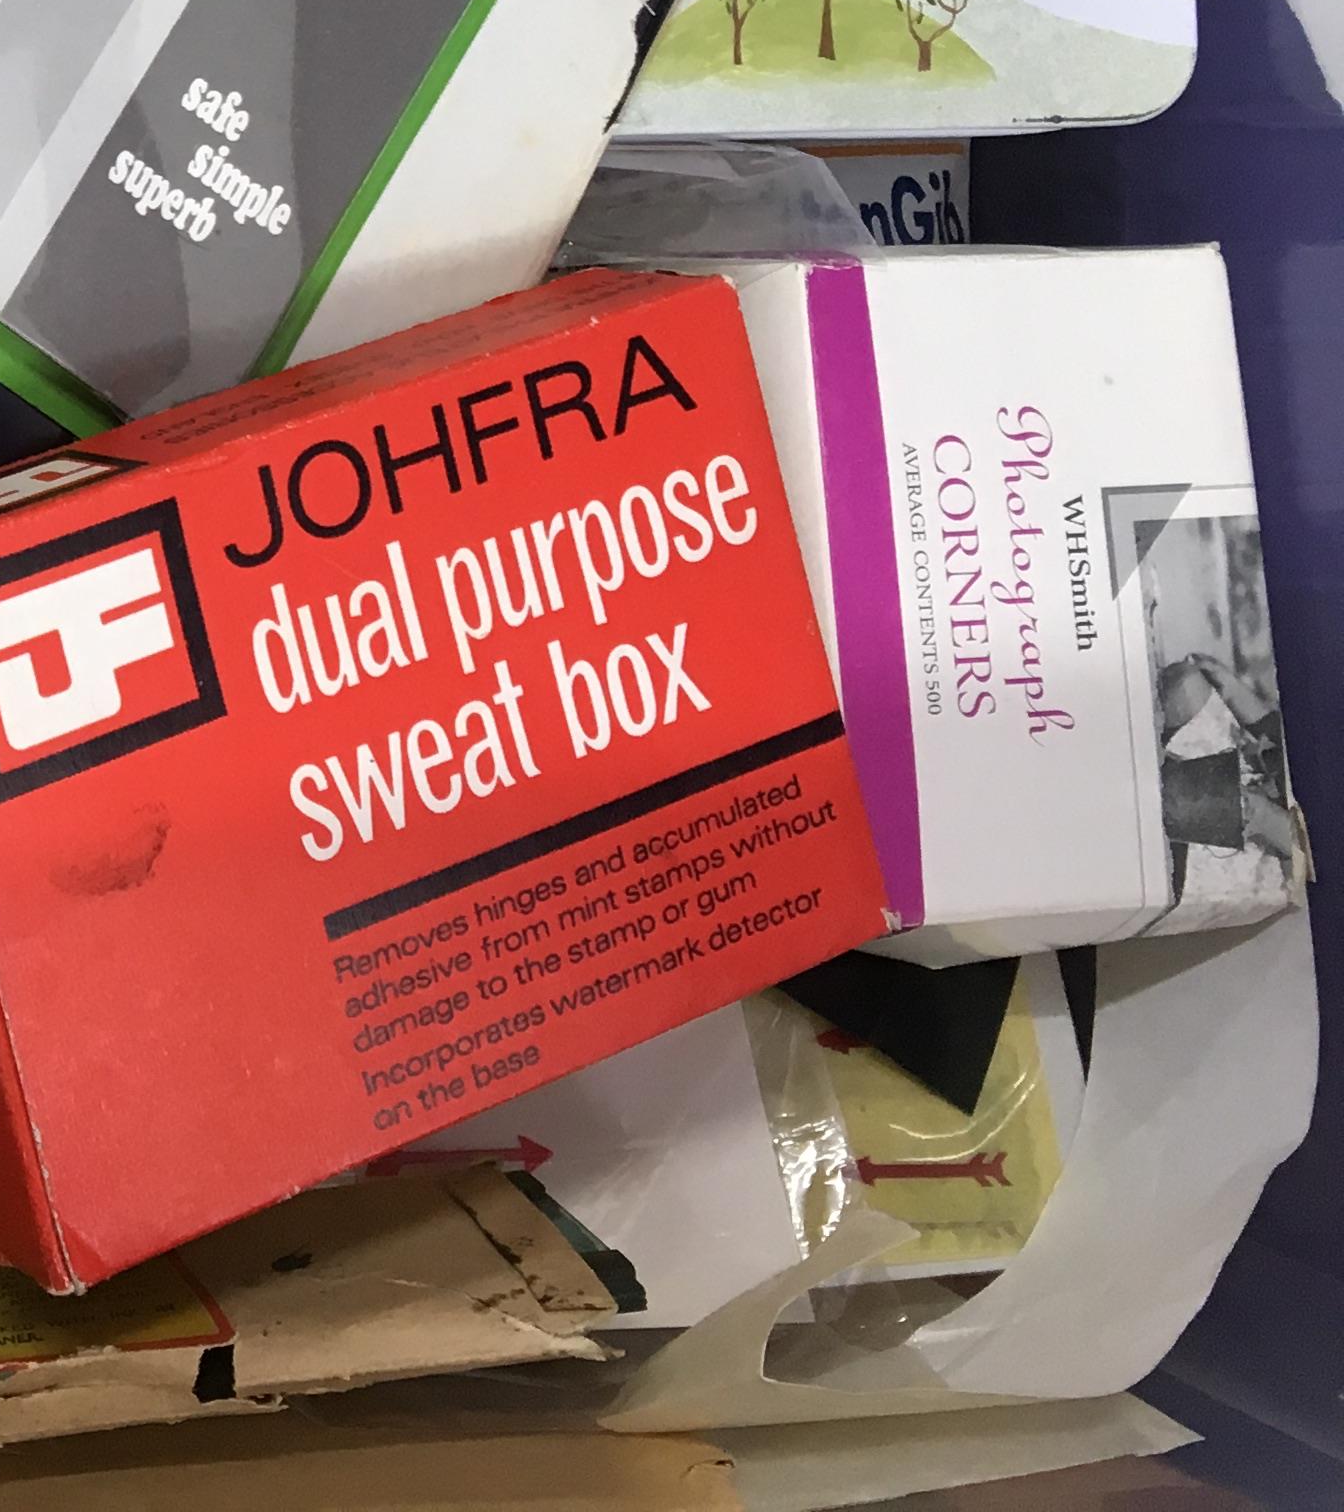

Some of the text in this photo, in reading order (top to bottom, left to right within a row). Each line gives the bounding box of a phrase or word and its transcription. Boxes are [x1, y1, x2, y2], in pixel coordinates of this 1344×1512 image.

[108, 150, 217, 242] superb
[182, 78, 249, 141] safe
[187, 145, 292, 235] simple
[224, 334, 695, 569] JOHFRA
[250, 453, 759, 713] dual purpose
[901, 443, 942, 715] AVERAGE CONTENTS 500
[934, 435, 996, 719] CORNERS
[991, 405, 1075, 746] Photograph
[1061, 494, 1098, 652] WHSmith
[286, 622, 712, 861] sweat box
[333, 774, 802, 984] Removes hinges and accumulated
[345, 800, 838, 1018] adhesive from mint stamps without
[353, 872, 757, 1054] damage to the stamp or gum
[361, 888, 822, 1096] Incorporates watermark detector
[373, 1045, 541, 1130] on the base
